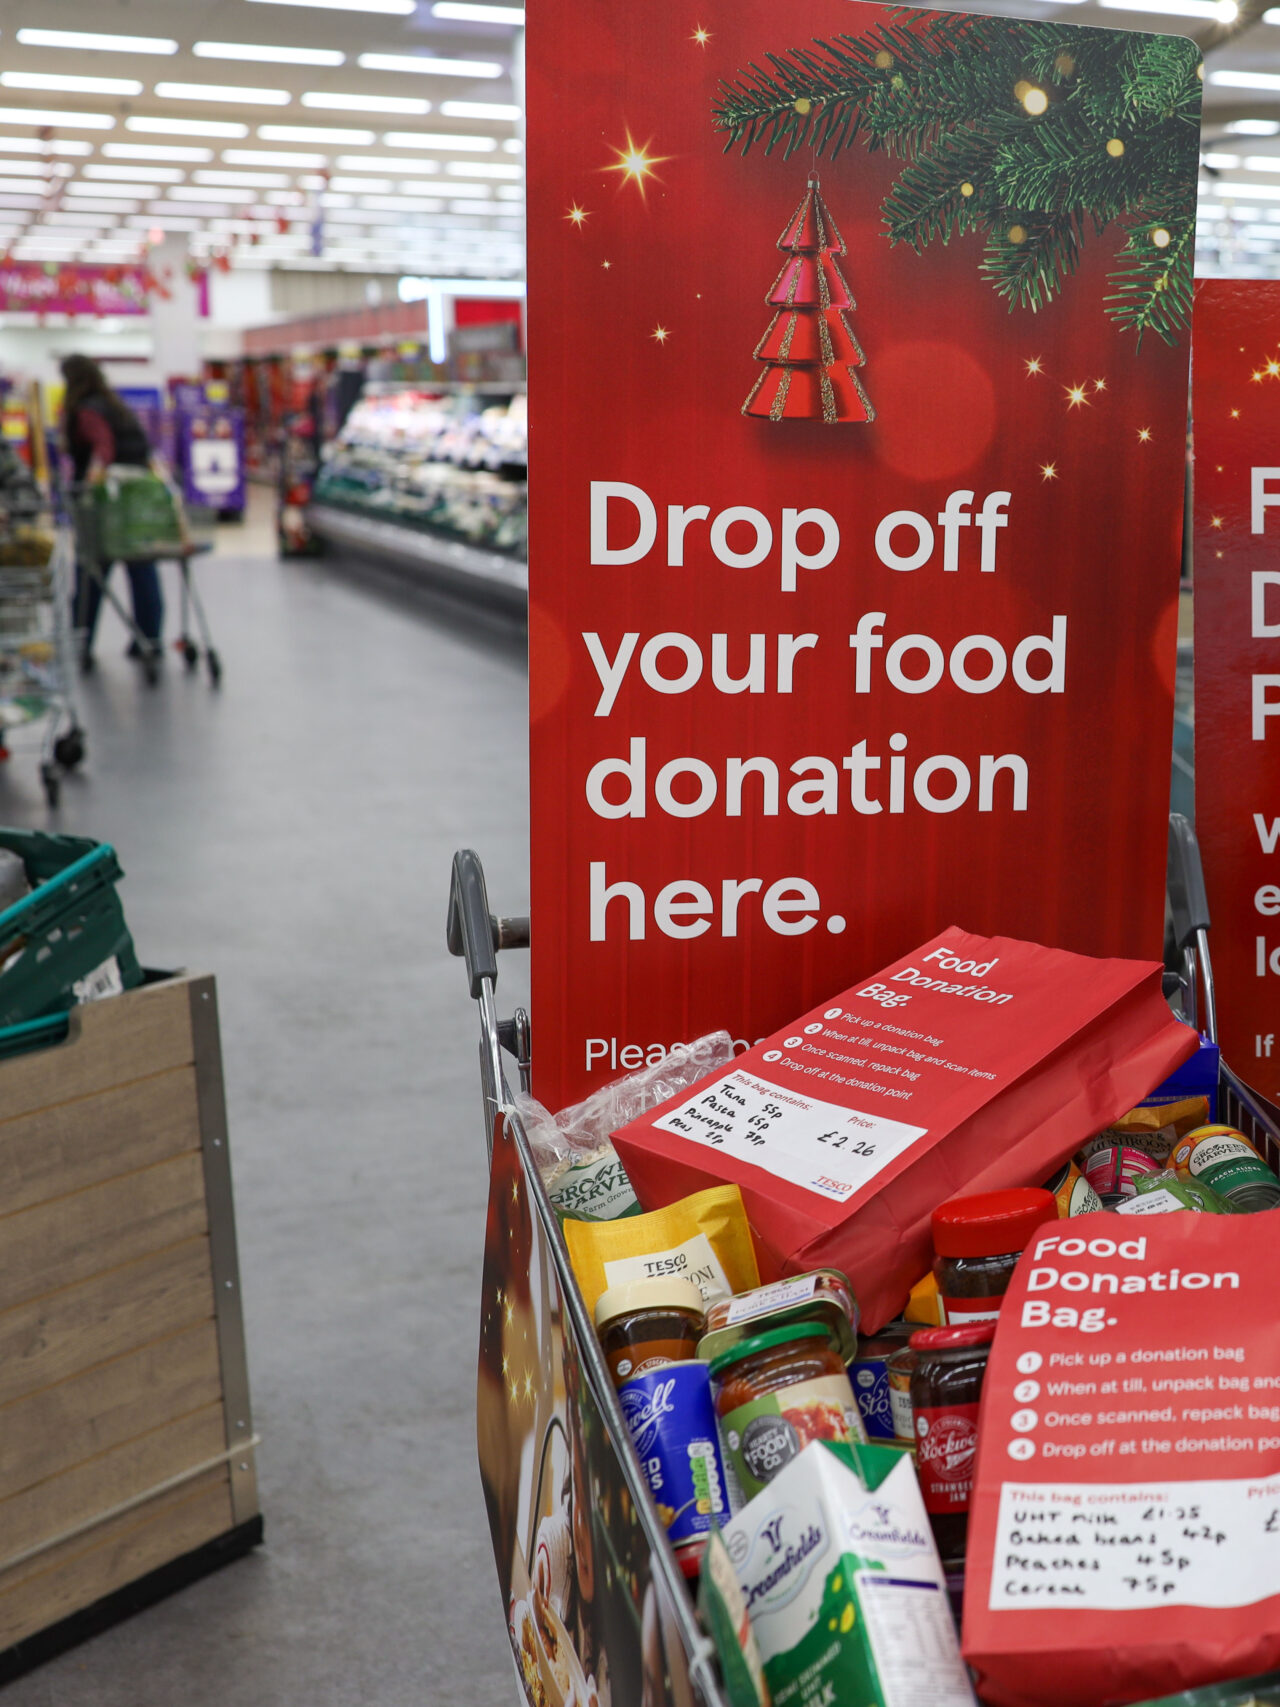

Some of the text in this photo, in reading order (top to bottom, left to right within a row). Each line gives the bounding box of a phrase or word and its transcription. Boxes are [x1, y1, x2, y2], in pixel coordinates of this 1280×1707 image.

[589, 481, 1012, 592] Drop off
[582, 612, 1068, 717] your food
[585, 732, 1029, 819] donation
[588, 861, 848, 942] here.
[922, 947, 1000, 978] Food
[855, 983, 913, 1008] Bag.
[889, 967, 1014, 1005] Donation
[841, 1012, 944, 1047] Pick donation bag
[822, 1028, 998, 1081] When unpack bag and scan items
[1254, 1033, 1275, 1058] If
[801, 1043, 921, 1082] Once repack bag
[780, 1057, 913, 1101] Drop off the donation point
[700, 1094, 770, 1131] Pasta 65p
[719, 1083, 783, 1119] Tuna 55p
[732, 1074, 877, 1129] This bag contains: Price:
[668, 1117, 693, 1132] Peas
[814, 1175, 853, 1192] TESCO
[1210, 1169, 1235, 1185] PEACH
[582, 1201, 606, 1214] Farm
[1032, 1236, 1148, 1261] Food
[644, 1253, 687, 1274] TESCO
[1026, 1266, 1240, 1295] Donation
[1019, 1299, 1119, 1333] Bag.
[1049, 1345, 1245, 1367] Pick up donation bag
[1047, 1381, 1097, 1396] When
[1100, 1380, 1119, 1394] at
[1151, 1375, 1215, 1394] unpack
[1218, 1374, 1250, 1392] bag
[1044, 1410, 1093, 1428] Once
[1181, 1404, 1244, 1424] repack
[1247, 1403, 1280, 1422] bag
[750, 1433, 787, 1465] FOOD
[1042, 1442, 1087, 1460] Drop
[1089, 1439, 1117, 1456] off
[1118, 1439, 1137, 1455] at
[1141, 1437, 1172, 1453] the
[1174, 1435, 1254, 1453] donation
[1010, 1490, 1045, 1502] This
[1050, 1491, 1082, 1507] bag
[1087, 1492, 1169, 1504] contains:
[1181, 1525, 1227, 1546] 42p
[1005, 1554, 1101, 1571] Peaches
[1121, 1576, 1176, 1595] 75p
